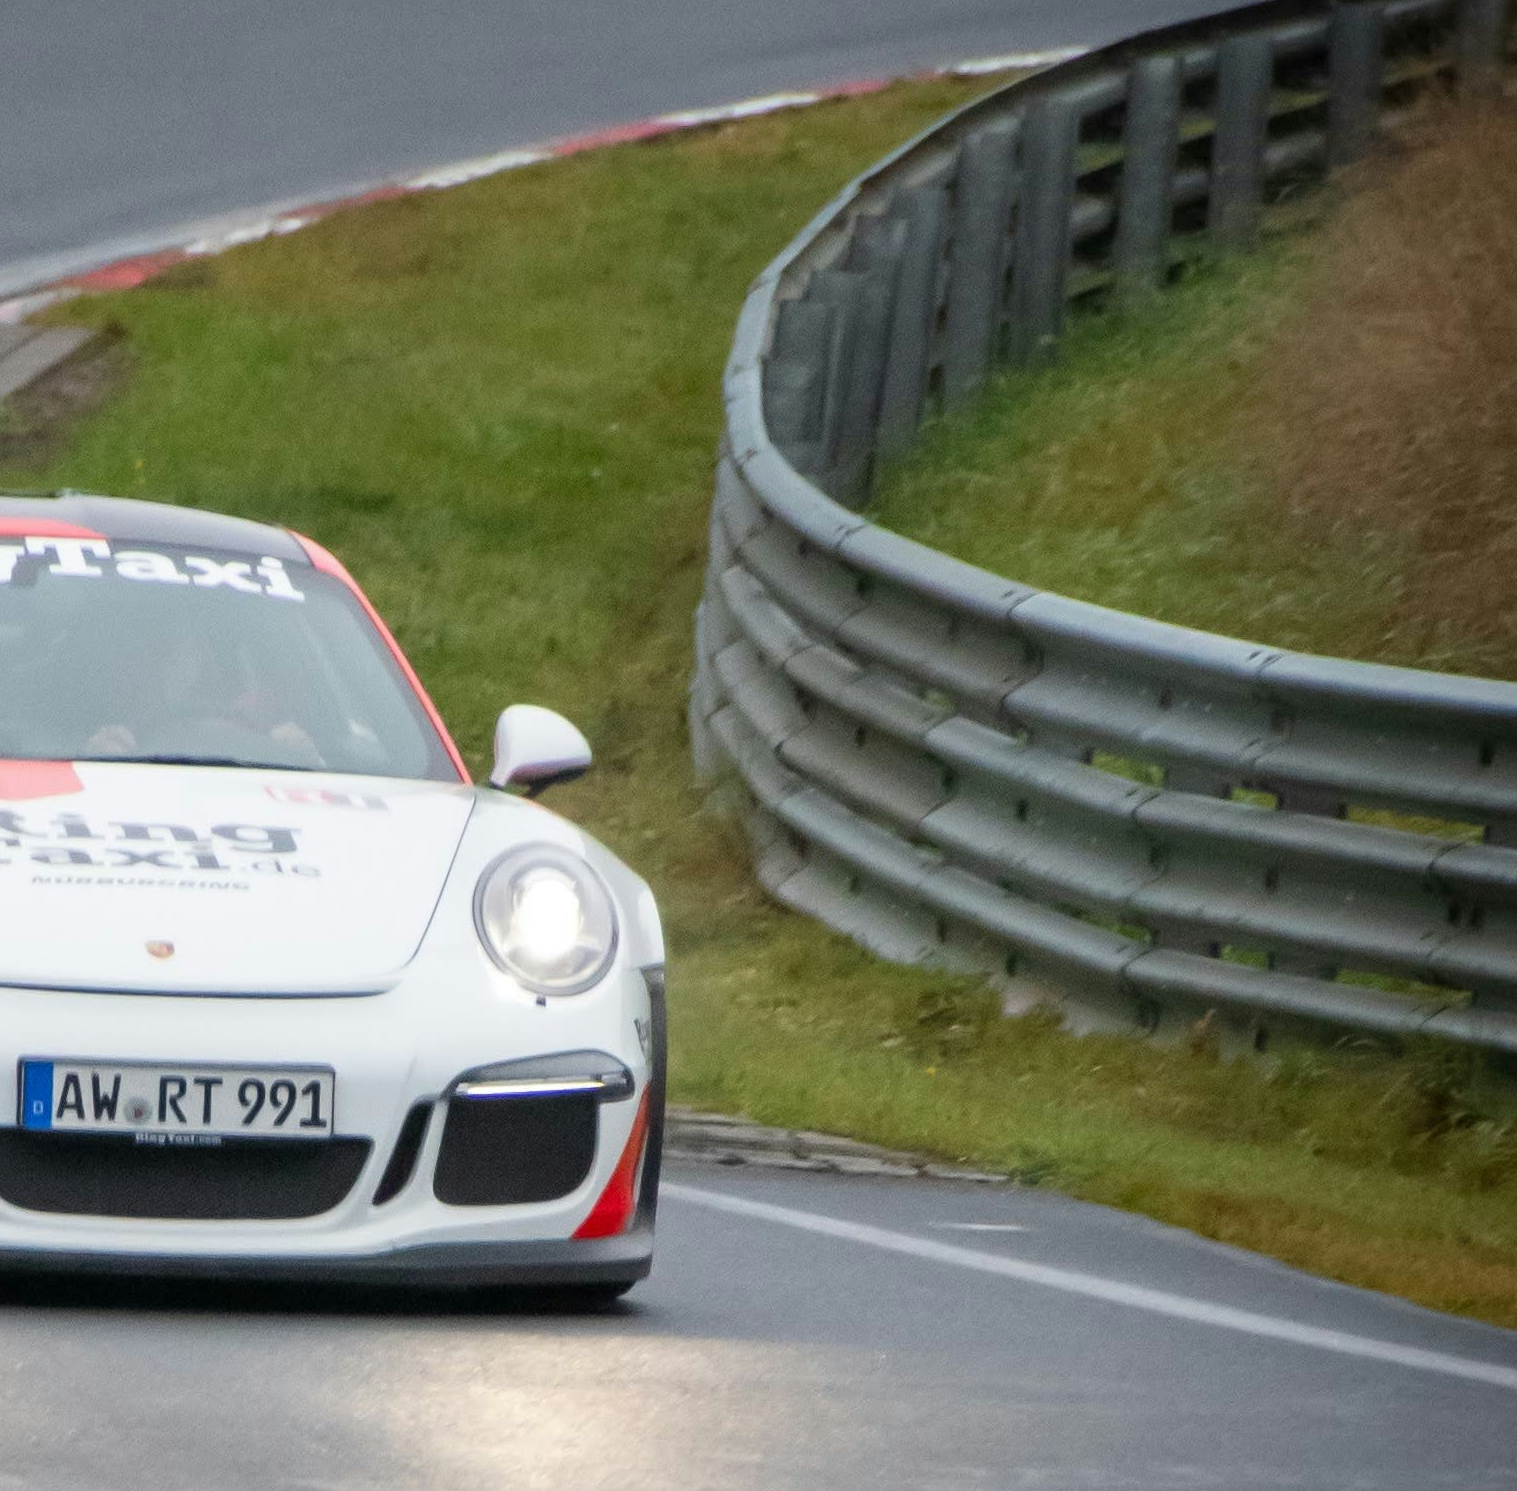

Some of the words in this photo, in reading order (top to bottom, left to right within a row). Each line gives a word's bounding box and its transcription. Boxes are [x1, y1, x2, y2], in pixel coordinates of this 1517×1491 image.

[55, 1069, 122, 1122] AW
[158, 1074, 224, 1125] RT
[236, 1078, 328, 1129] 991
